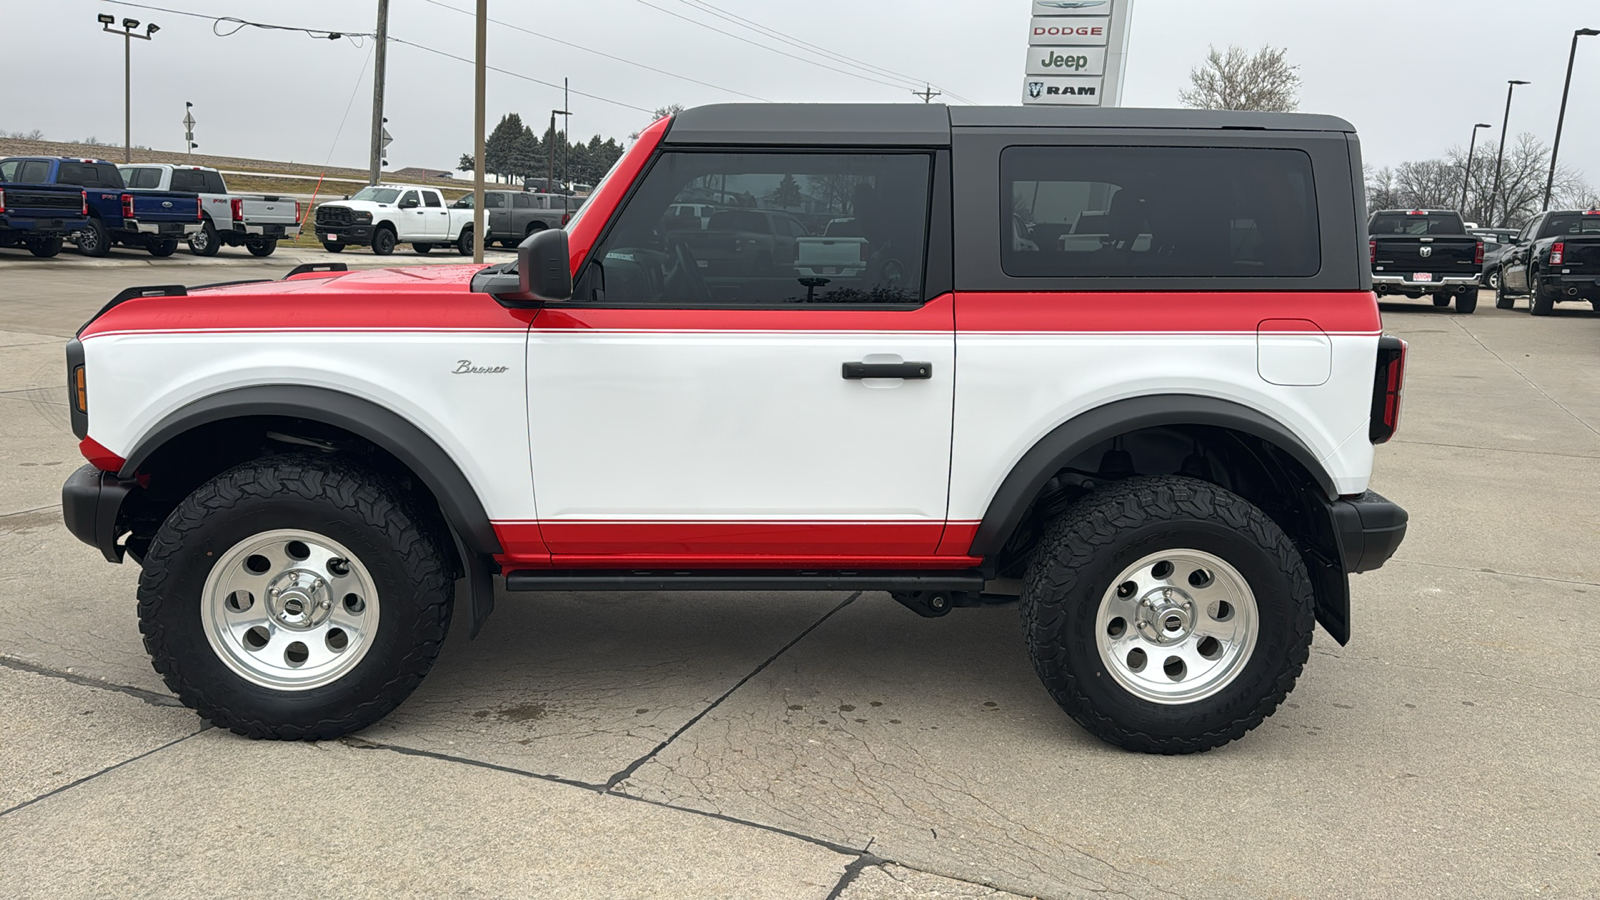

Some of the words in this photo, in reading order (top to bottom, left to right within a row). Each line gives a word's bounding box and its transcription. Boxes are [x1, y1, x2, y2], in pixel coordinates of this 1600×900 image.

[1033, 27, 1103, 35] DODGE
[1041, 51, 1088, 71] Jeep
[1046, 86, 1096, 95] RAM
[451, 360, 509, 374] Bronco
